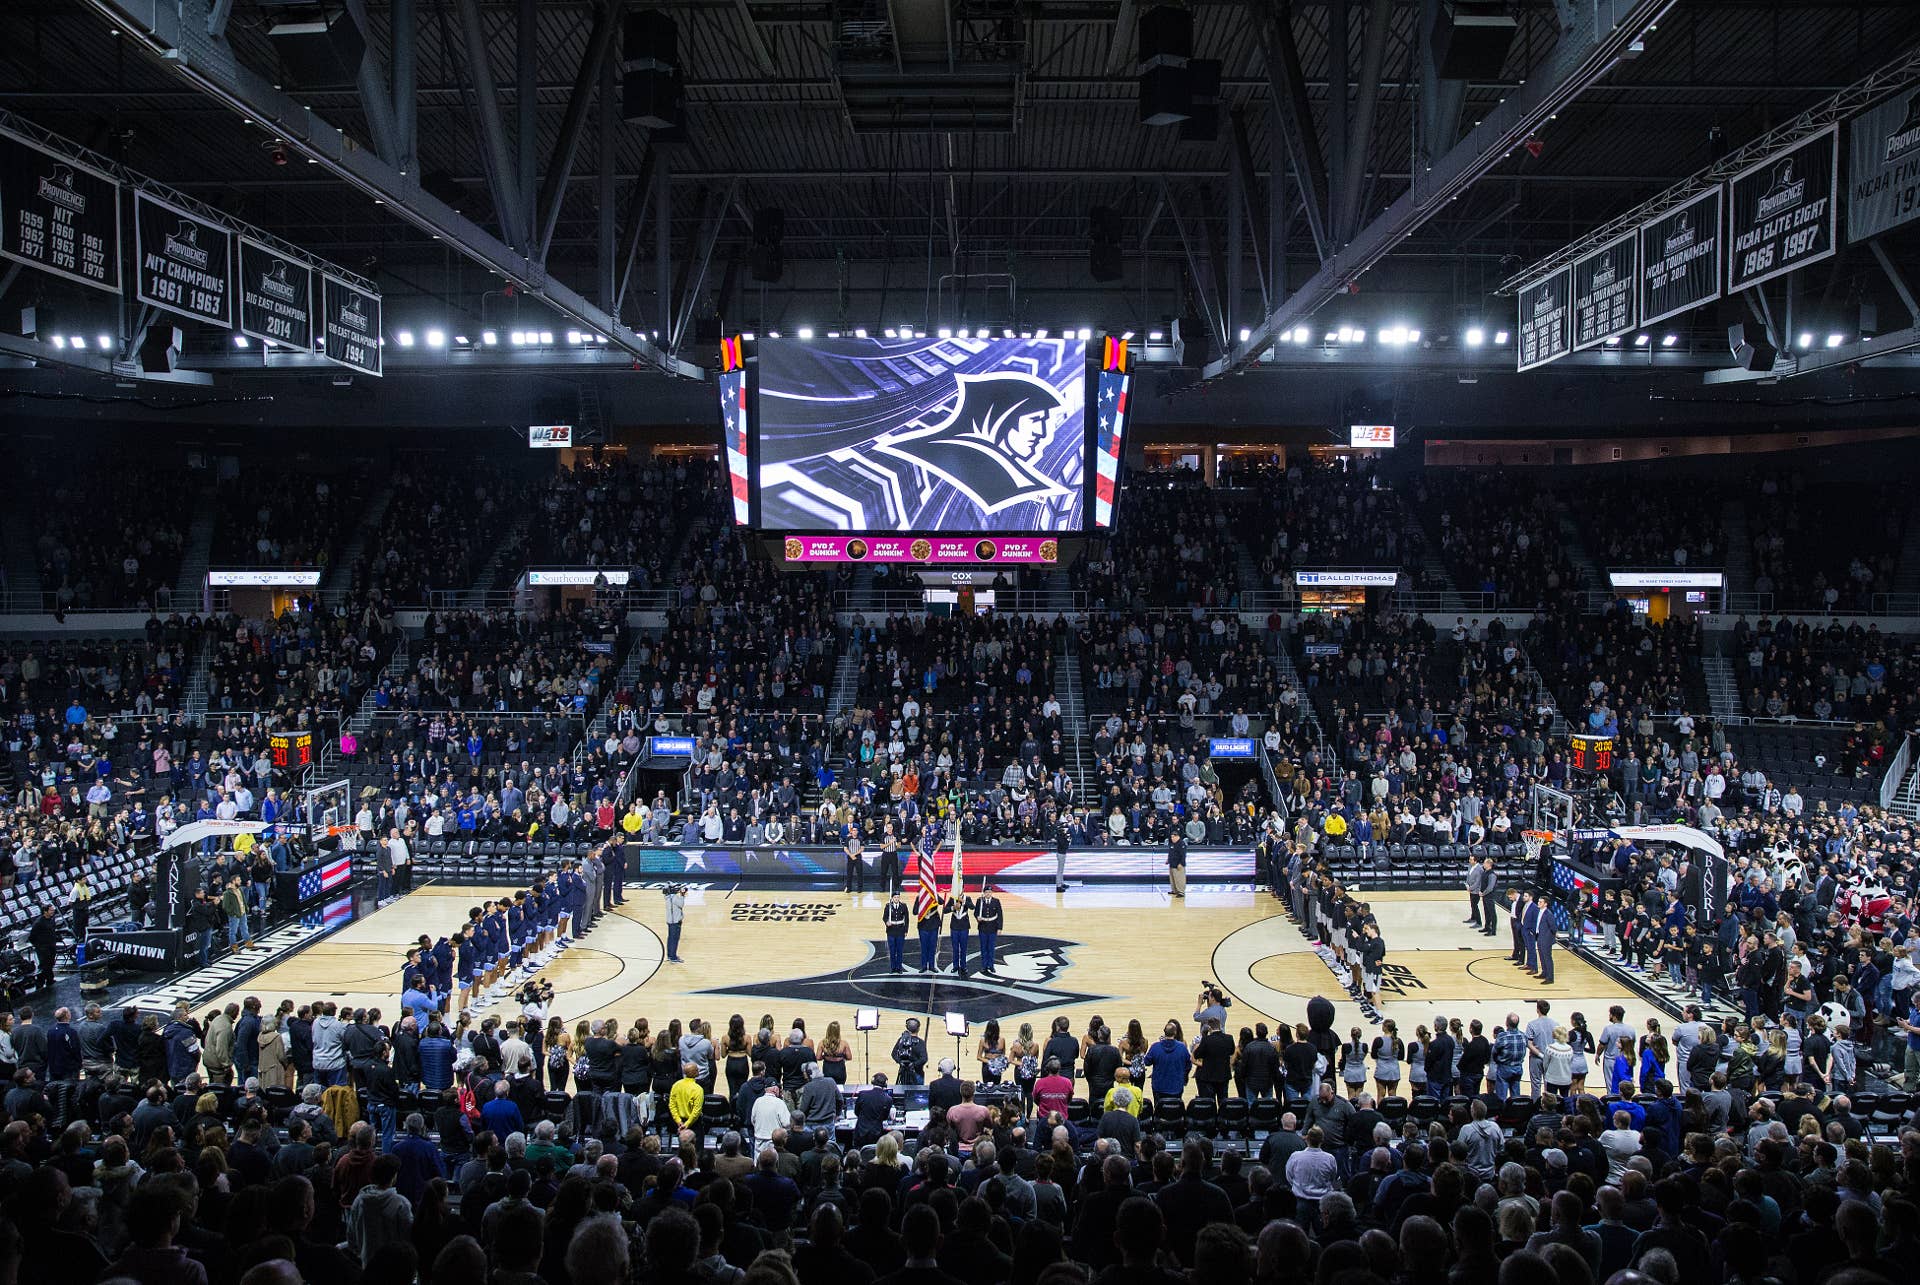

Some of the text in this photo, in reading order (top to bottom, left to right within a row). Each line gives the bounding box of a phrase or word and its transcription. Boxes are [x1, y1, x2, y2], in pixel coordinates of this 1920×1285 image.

[41, 180, 84, 207] PROVIDENCE
[1856, 172, 1889, 201] NCAA
[1758, 182, 1803, 218] PROVIDENCE
[1894, 183, 1920, 217] 19
[19, 209, 44, 229] 1959
[52, 205, 74, 225] NIT
[1735, 232, 1761, 253] NCAA
[1763, 211, 1792, 242] ELITE
[1793, 197, 1828, 228] EIGHT
[20, 225, 44, 244] 1962
[51, 221, 74, 240] 1960
[20, 239, 44, 259] 1971
[51, 235, 74, 254] 1963
[81, 232, 103, 251] 1961
[166, 236, 206, 264] PROVIDENCE
[1742, 223, 1819, 278] 1965 1997
[52, 250, 75, 269] 1975
[82, 246, 104, 266] 1967
[1665, 237, 1715, 271] TOURNAMENT
[82, 261, 104, 279] 1976
[144, 252, 167, 274] NIT
[167, 261, 224, 294] CHAMPIONS
[262, 276, 294, 297] PROVIDENCE
[1652, 273, 1668, 291] 2017
[150, 275, 221, 315] 1961 1963
[245, 291, 258, 305] BIG
[258, 296, 275, 311] EAST
[275, 301, 307, 323] CHAMPIONS
[266, 316, 292, 339] 2014
[338, 325, 350, 338] EAST
[350, 330, 378, 349] CHAMPIONS
[345, 343, 364, 364] 1994
[532, 427, 570, 439] NETS
[1354, 427, 1392, 439] NETS
[873, 549, 905, 557] DUNKIN'
[542, 573, 593, 583] Southcoast
[951, 572, 972, 580] COX
[273, 745, 310, 766] 30 30
[1573, 749, 1611, 770] 30 30
[1703, 855, 1715, 921] BANKRI
[101, 938, 166, 960] RIARTOWN
